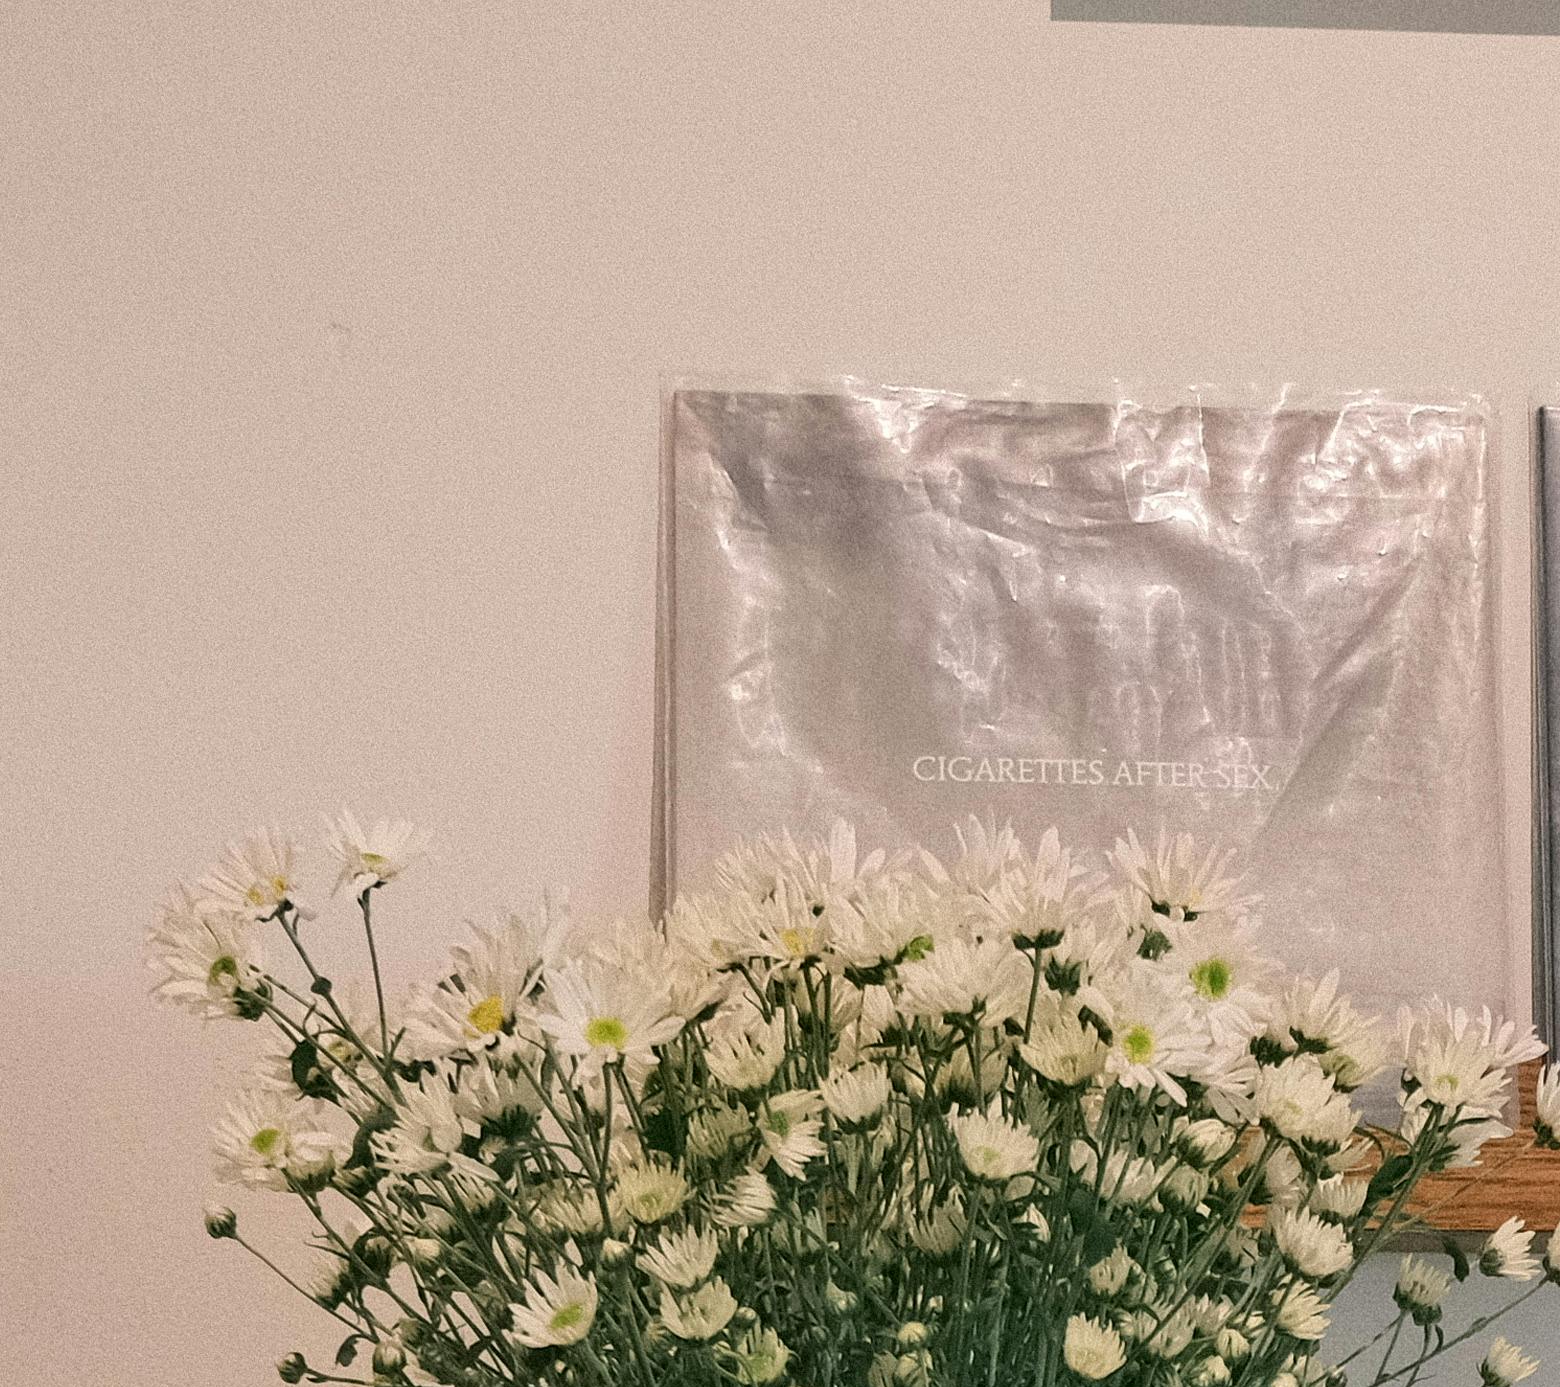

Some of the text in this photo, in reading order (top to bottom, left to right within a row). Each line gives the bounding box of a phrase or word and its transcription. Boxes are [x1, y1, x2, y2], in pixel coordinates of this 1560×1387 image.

[913, 756, 1272, 791] CIGARETTES AFTER SEX
